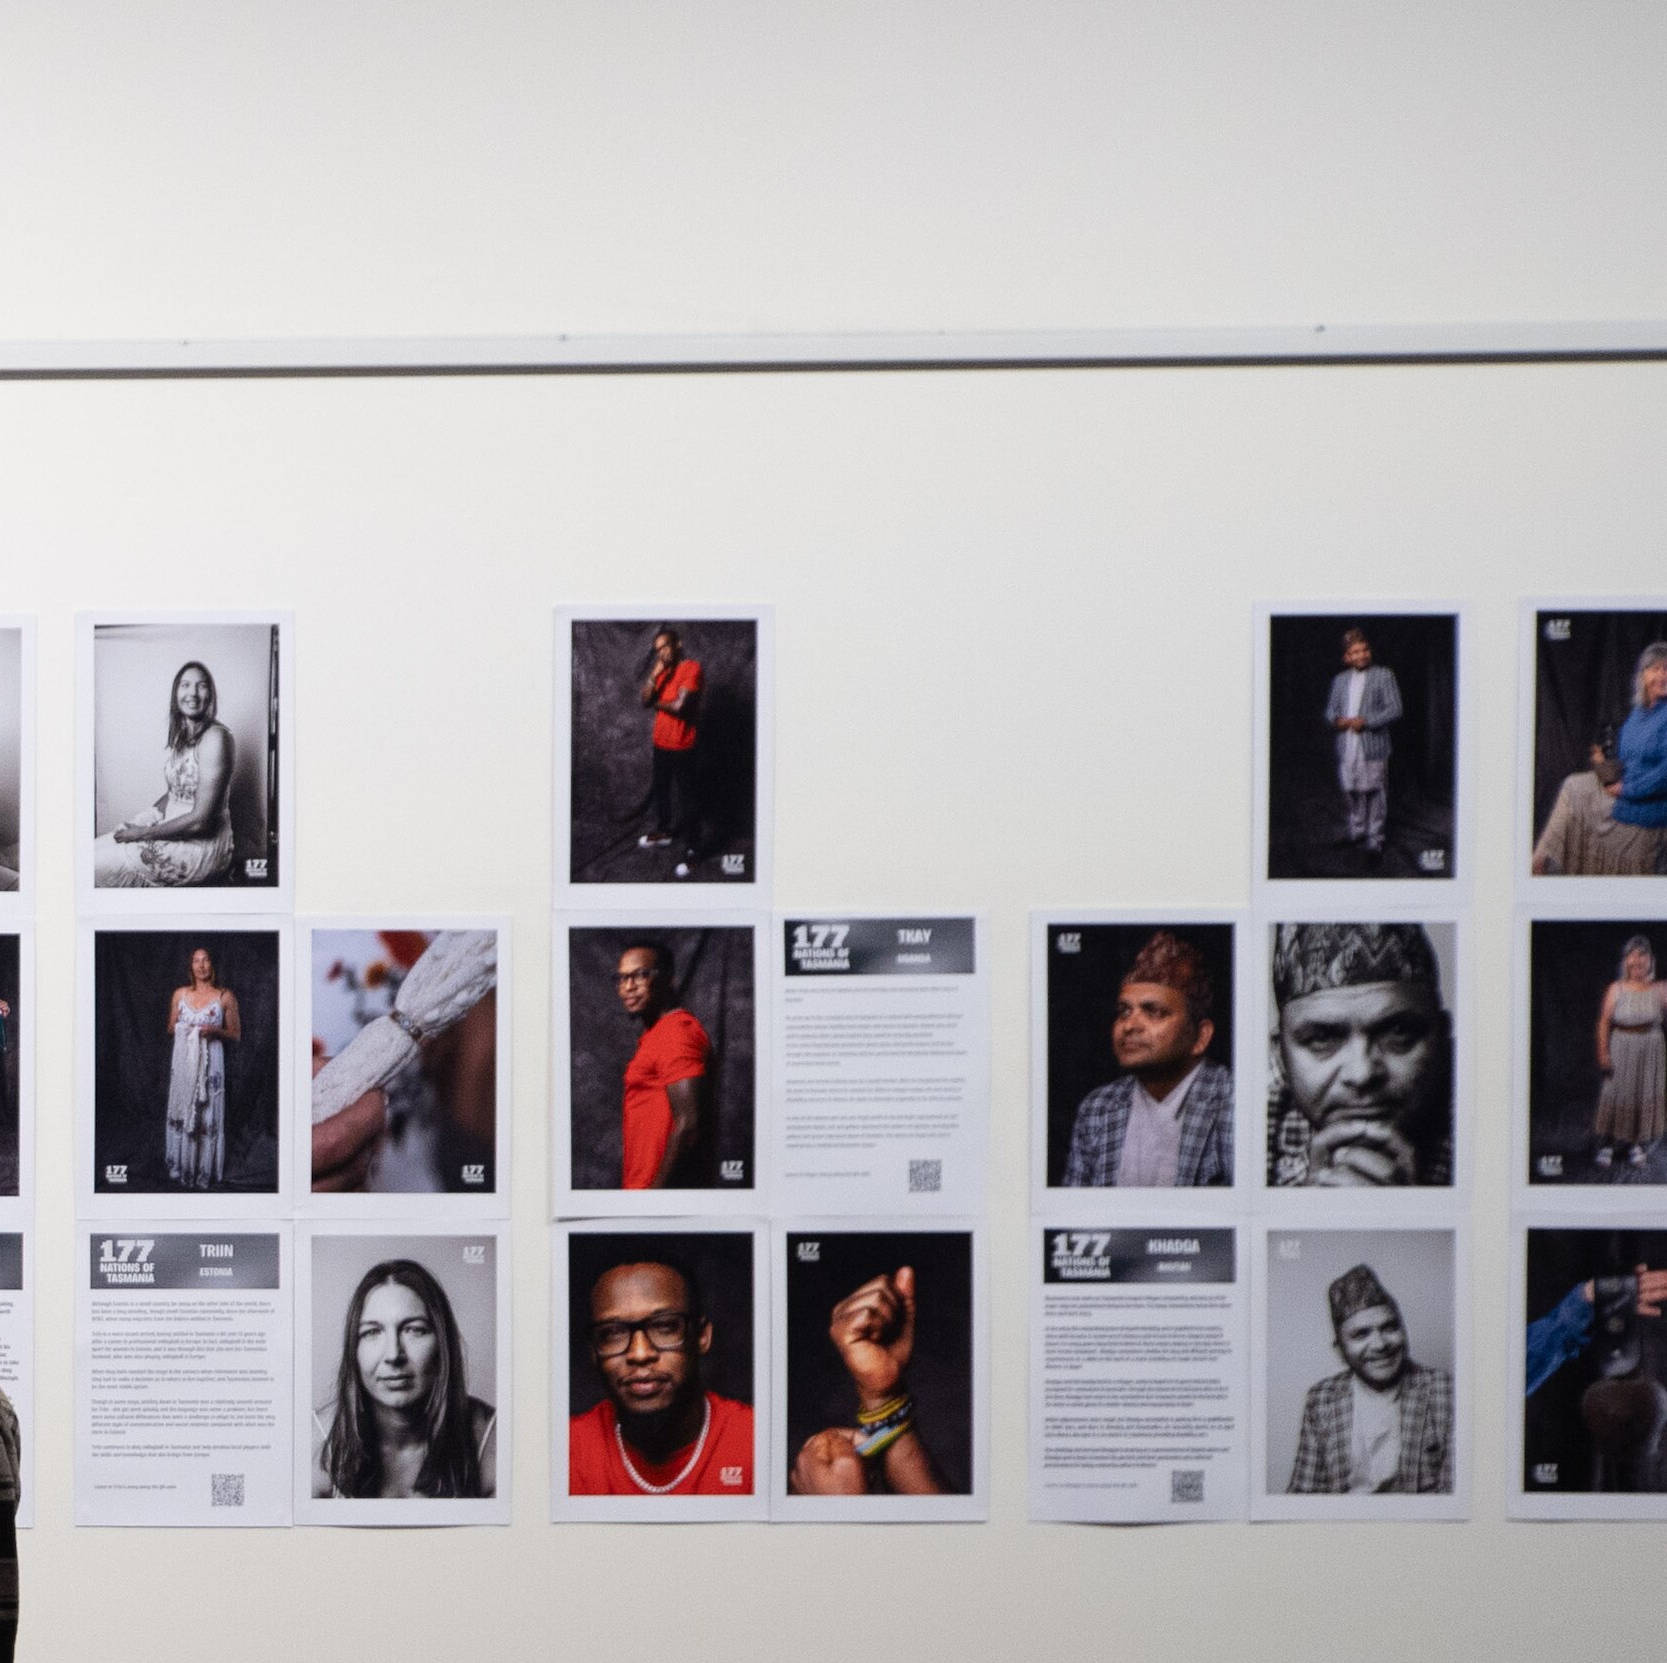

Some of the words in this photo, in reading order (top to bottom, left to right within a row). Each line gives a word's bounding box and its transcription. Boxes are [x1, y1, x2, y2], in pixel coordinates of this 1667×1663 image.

[246, 859, 267, 868] 177
[793, 924, 850, 948] 177
[897, 929, 932, 944] TKAY
[793, 948, 836, 959] NATIONS
[837, 947, 850, 957] OF
[800, 958, 851, 970] TASMANIA
[106, 1165, 128, 1174] 177
[462, 1165, 485, 1174] 177
[1052, 1233, 1111, 1256] 177
[1147, 1238, 1201, 1254] KHADGA
[100, 1240, 155, 1262] 177
[200, 1244, 234, 1258] TRIIN
[100, 1262, 141, 1272] NATIONS
[142, 1262, 155, 1272] OF
[199, 1267, 234, 1277] ESTONIA
[107, 1273, 155, 1283] TASMANIA
